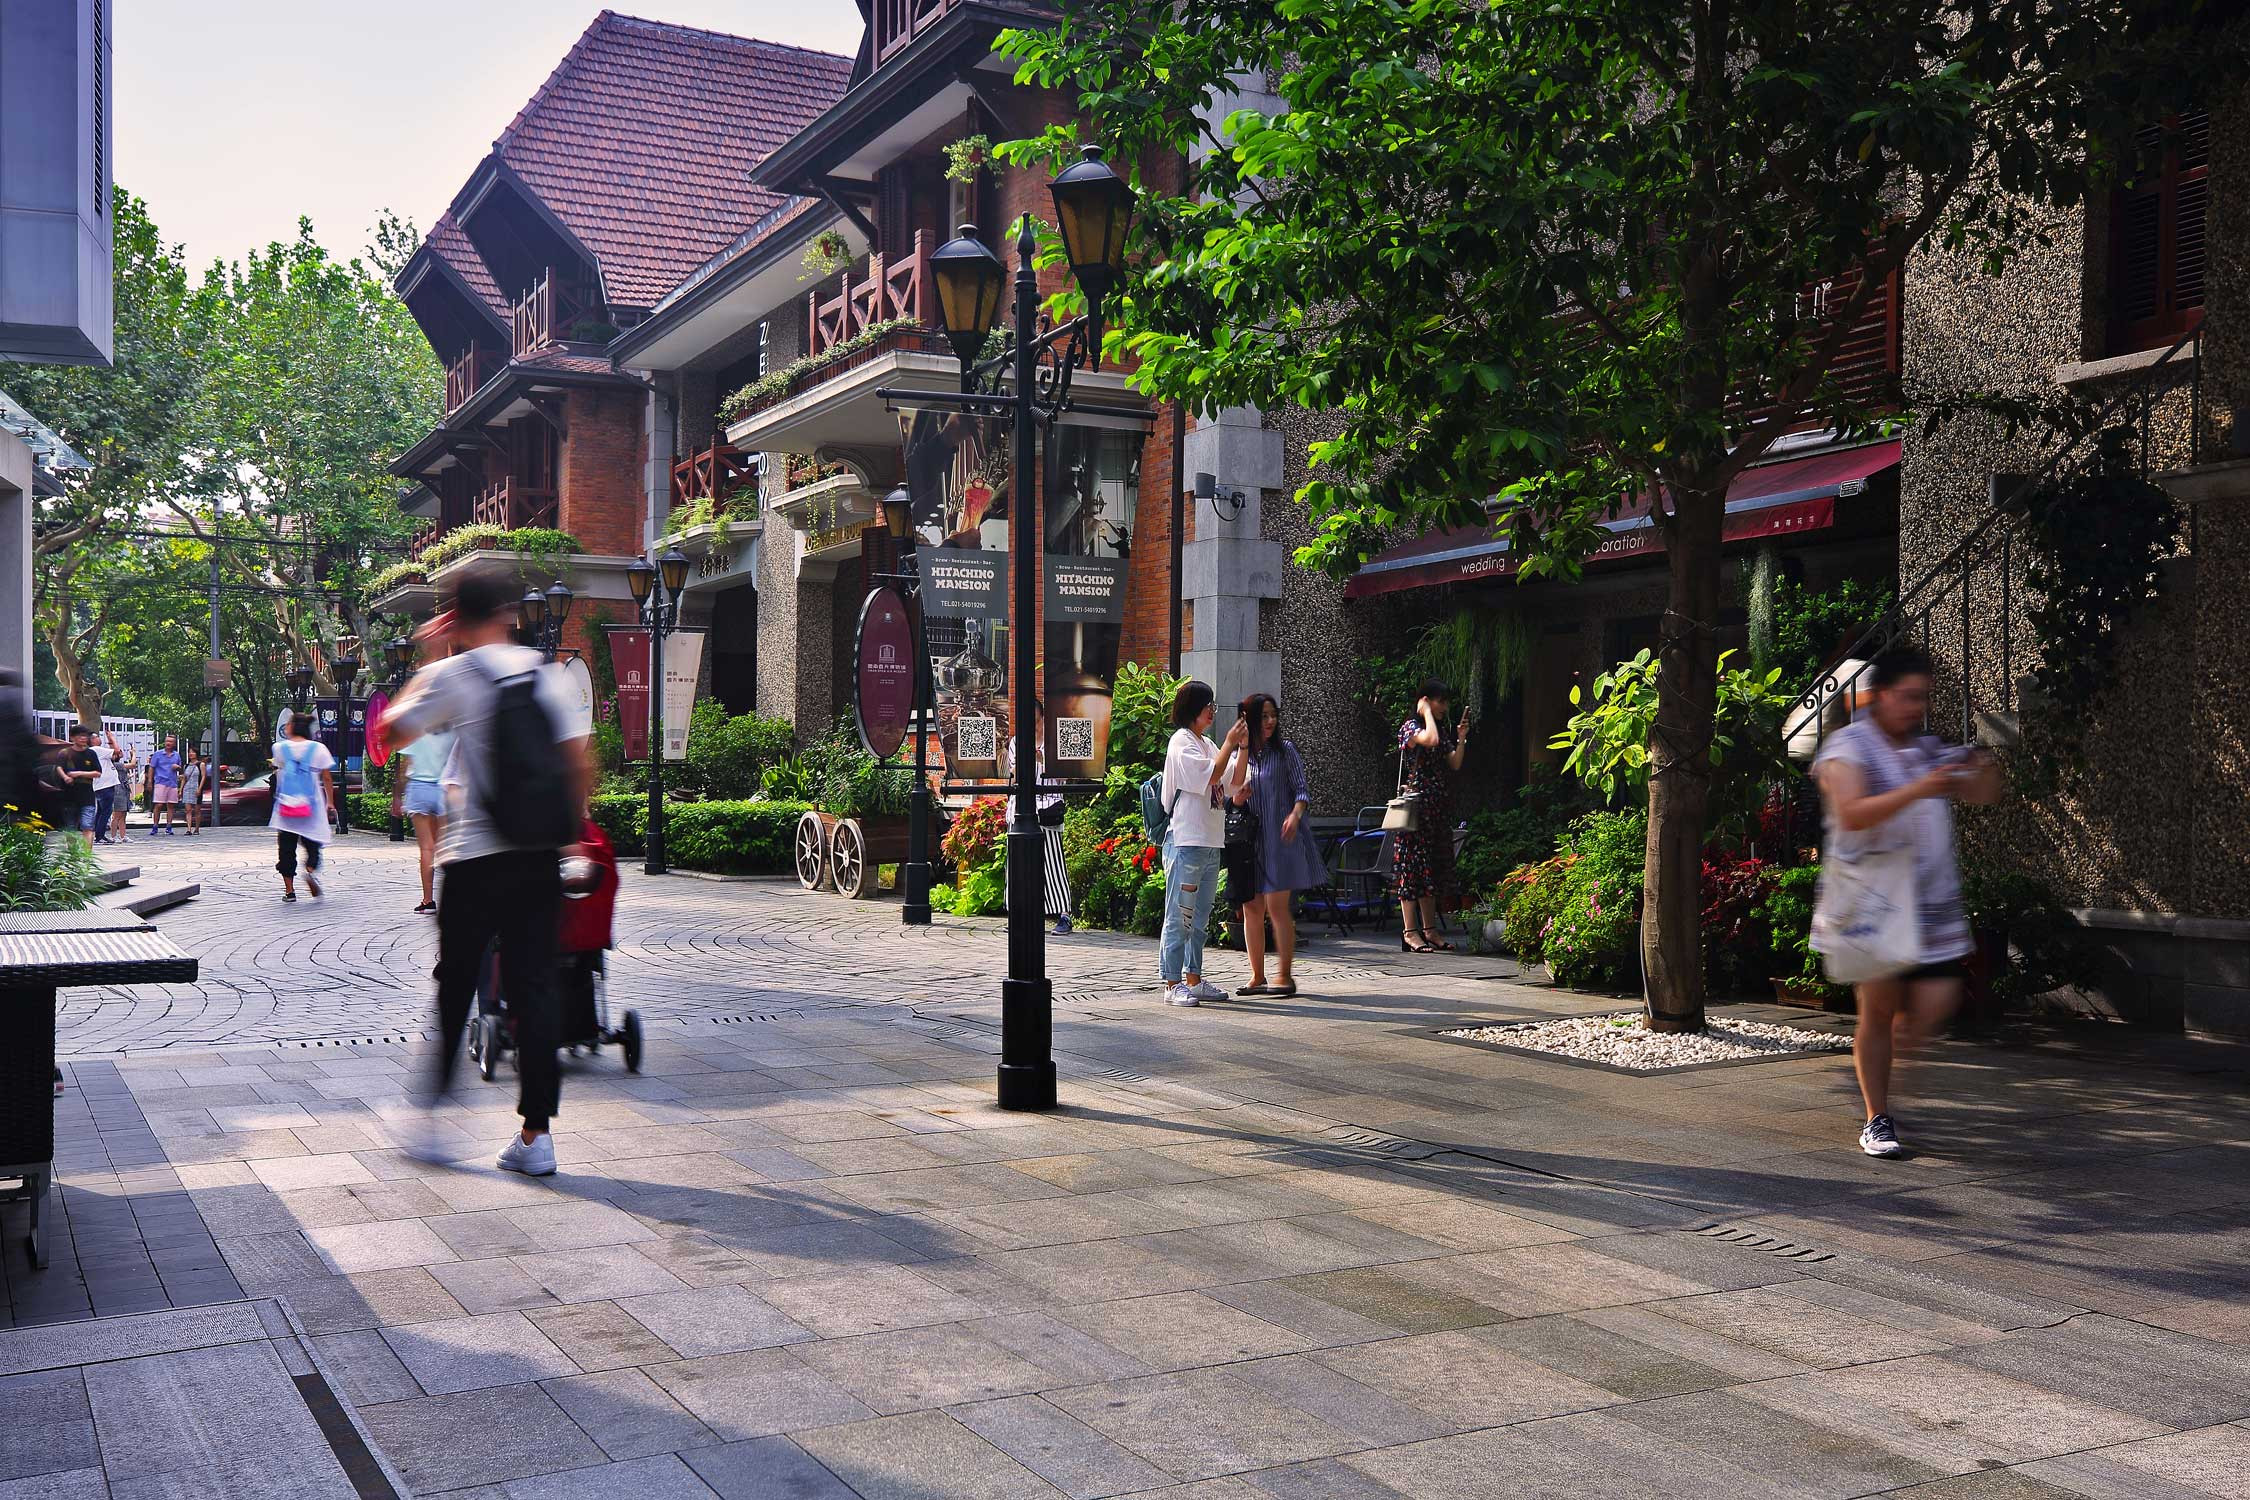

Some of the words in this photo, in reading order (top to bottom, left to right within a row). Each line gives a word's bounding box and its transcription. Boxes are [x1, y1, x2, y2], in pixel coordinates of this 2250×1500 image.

[1461, 556, 1505, 574] wedding
[931, 566, 995, 580] HITACHINO
[1055, 573, 1115, 586] HITACHINO
[935, 579, 991, 591] MANSION
[1059, 585, 1111, 597] MANSION
